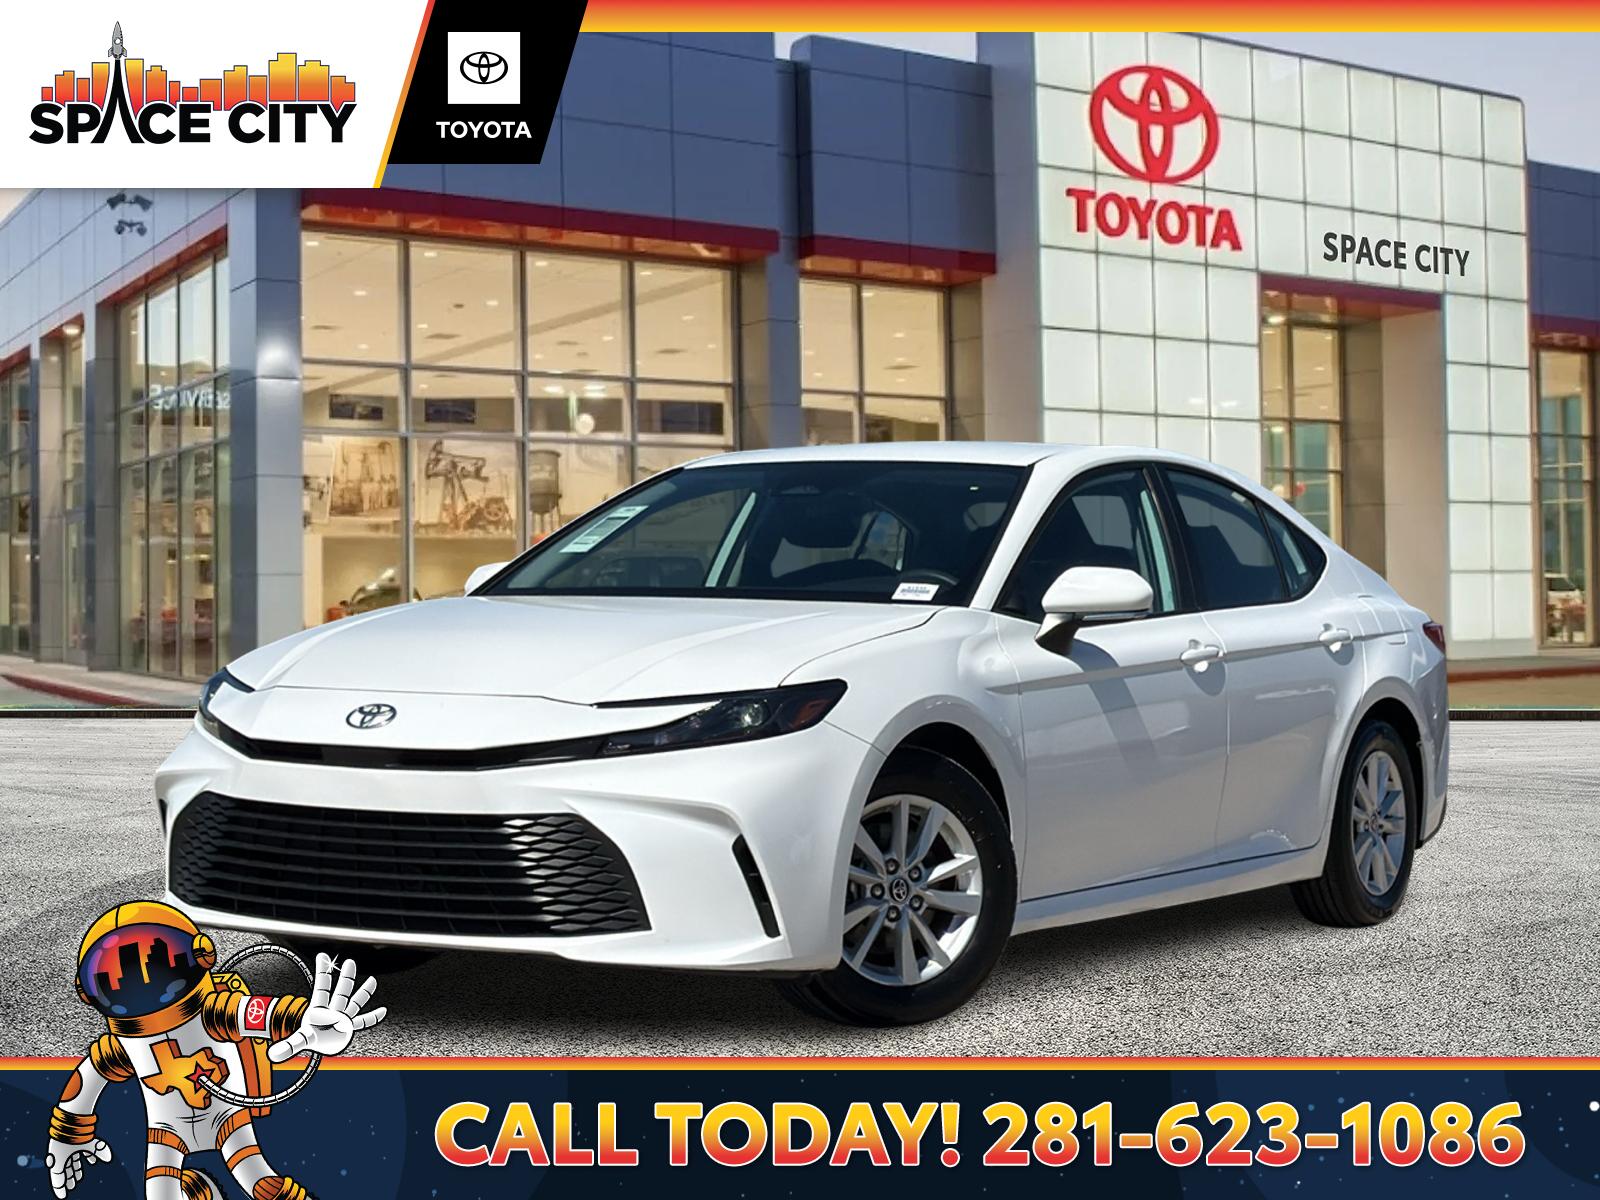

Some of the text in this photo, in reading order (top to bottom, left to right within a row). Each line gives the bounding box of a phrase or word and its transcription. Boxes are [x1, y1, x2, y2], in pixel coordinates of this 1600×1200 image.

[1066, 187, 1242, 251] TOYOTA
[1323, 231, 1470, 277] SPACE CITY
